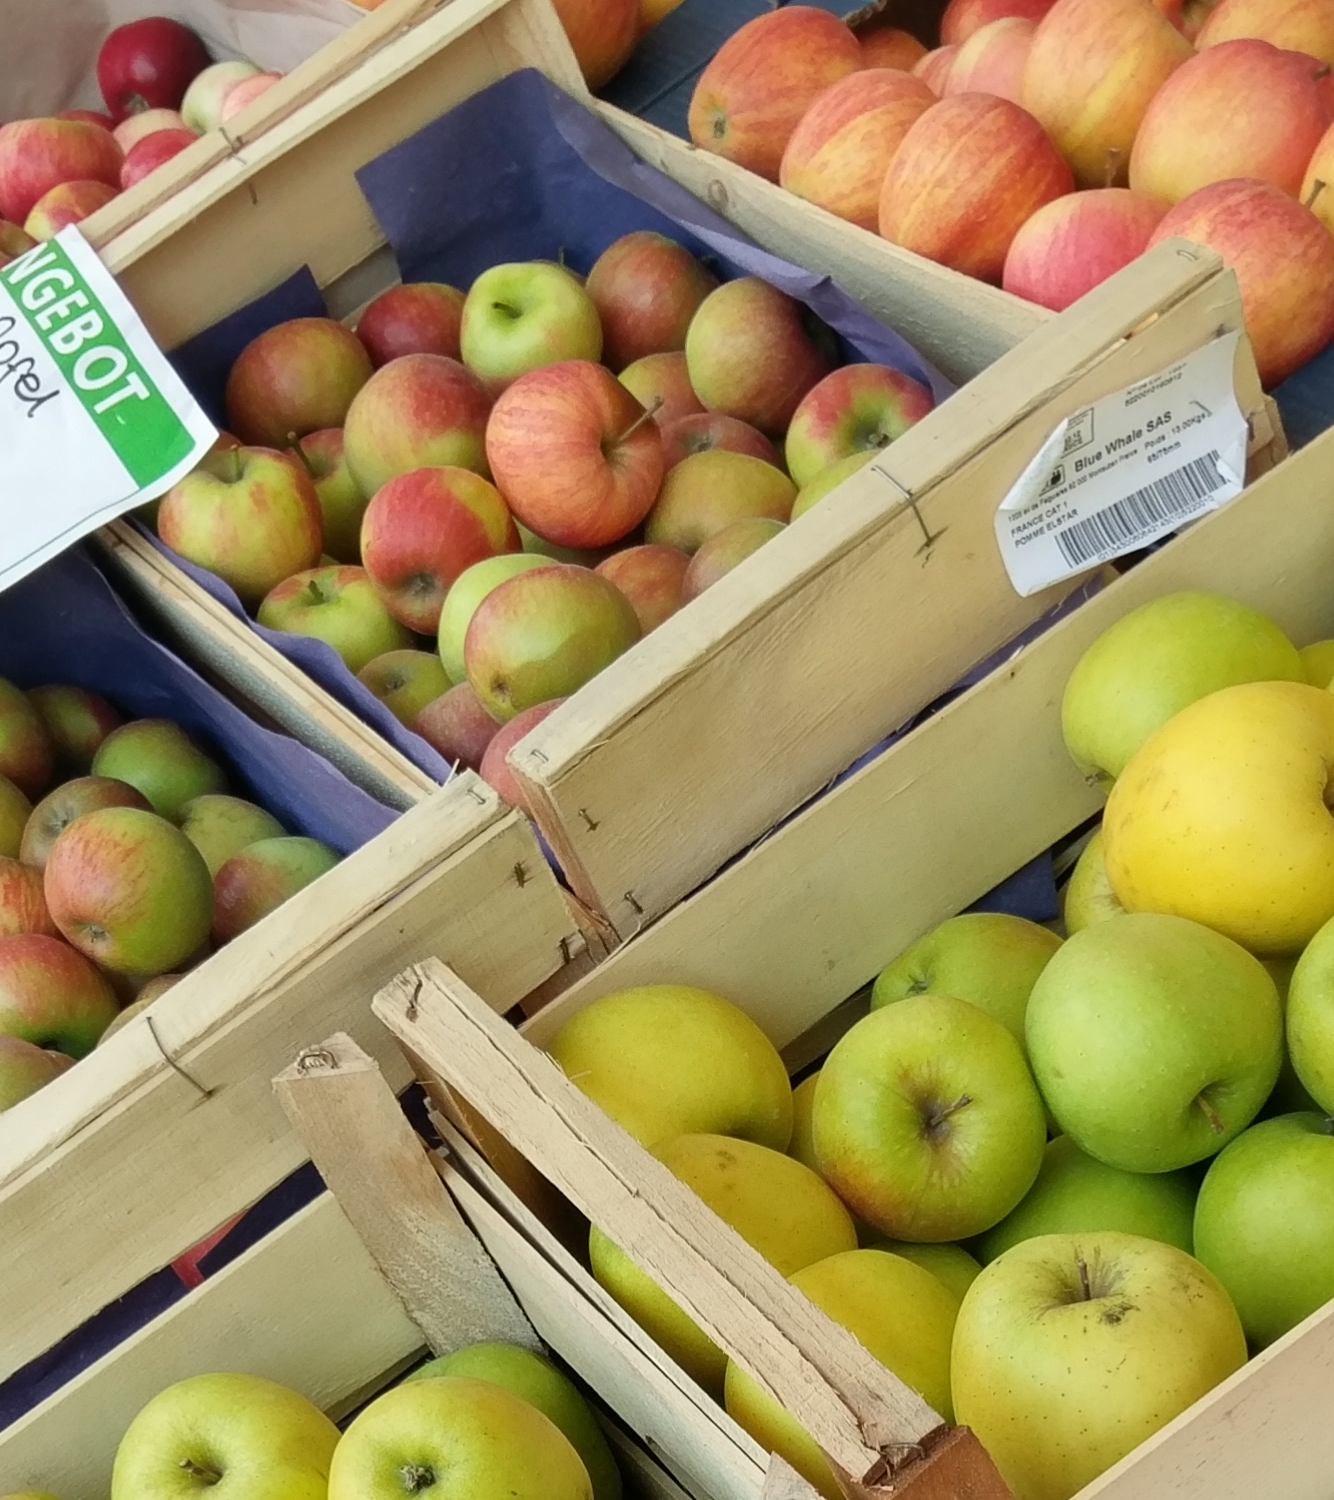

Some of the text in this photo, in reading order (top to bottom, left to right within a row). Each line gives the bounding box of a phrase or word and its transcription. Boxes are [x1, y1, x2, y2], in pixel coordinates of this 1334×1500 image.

[1074, 451, 1102, 472] Blue
[1104, 428, 1142, 454] Whale
[1146, 410, 1171, 432] SAS
[1010, 513, 1043, 534] FRANCE
[1045, 503, 1060, 518] CAT
[1014, 508, 1077, 546] POMME ELSTAR
